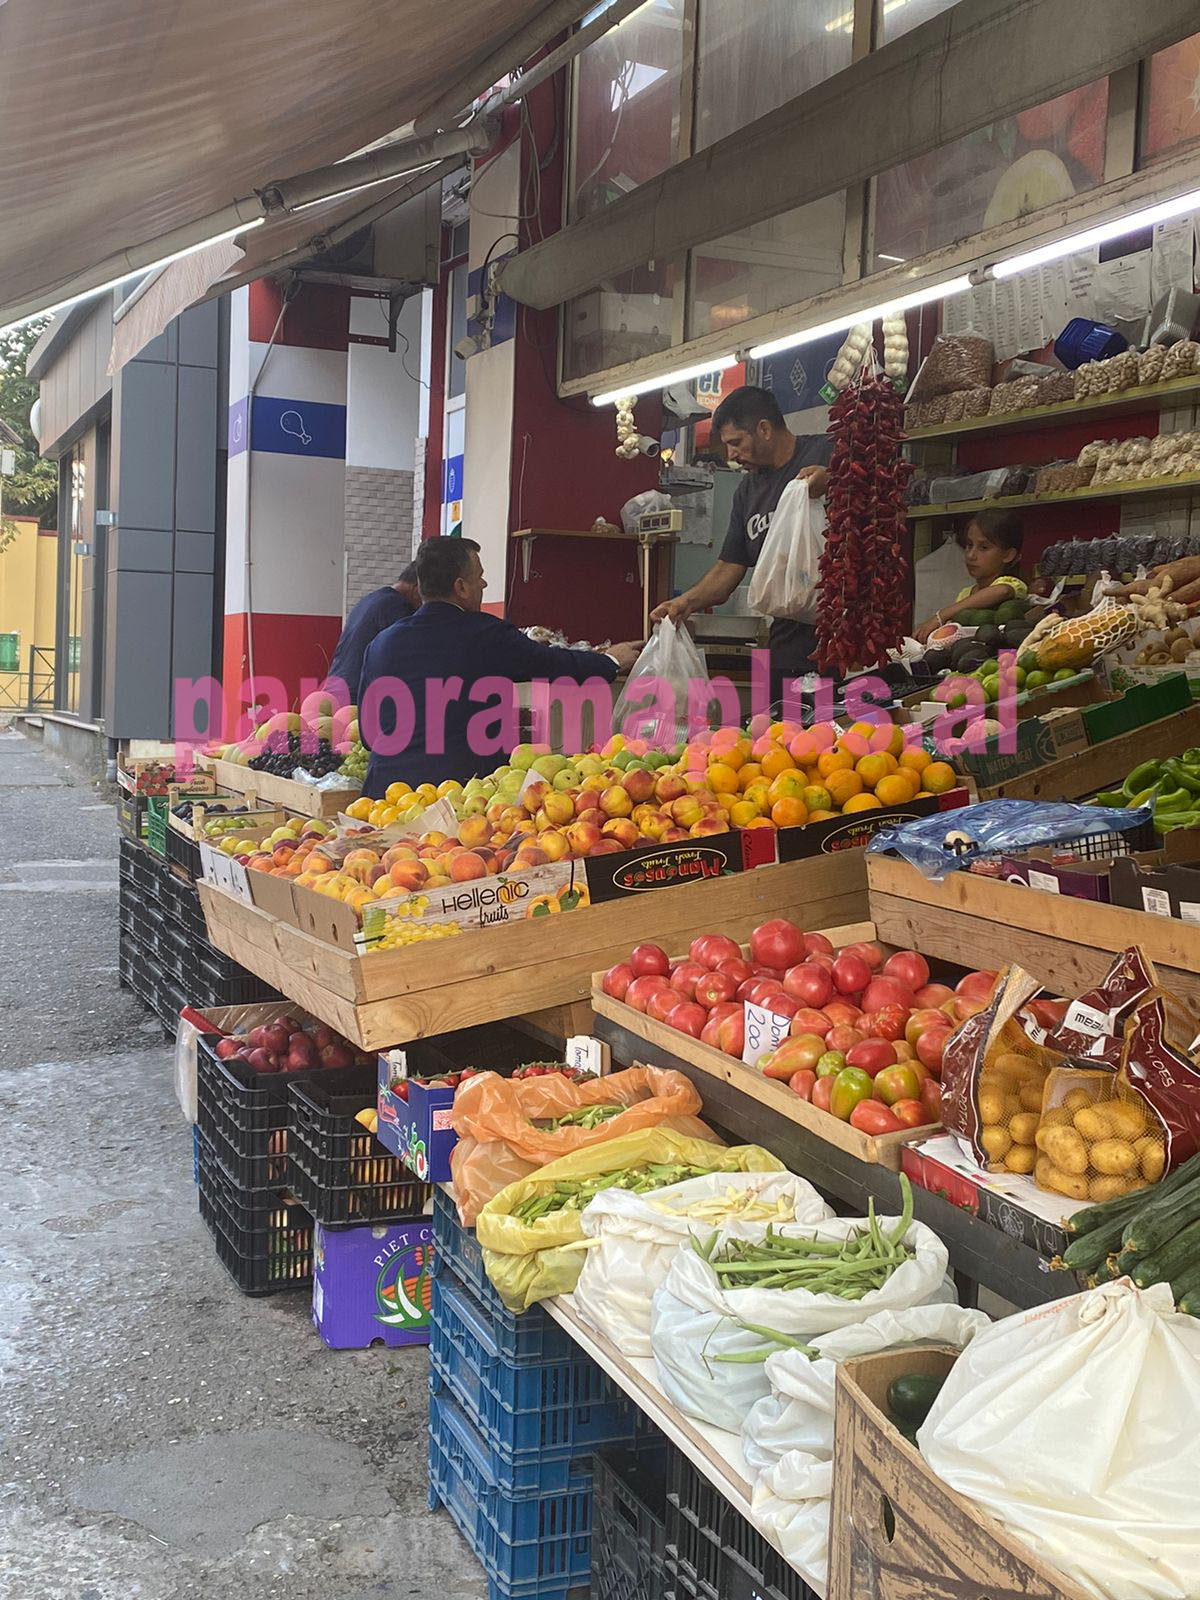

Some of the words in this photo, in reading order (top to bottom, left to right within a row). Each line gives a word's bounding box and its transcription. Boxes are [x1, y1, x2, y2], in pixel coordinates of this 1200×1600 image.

[747, 511, 774, 540] Ca
[641, 856, 671, 869] Fruits
[674, 850, 702, 864] Fresh
[442, 881, 530, 914] Hellenic
[480, 904, 509, 928] fruits
[747, 1009, 765, 1050] 200
[769, 1012, 791, 1052] Dom
[374, 1233, 410, 1267] PIET
[419, 1228, 429, 1241] C
